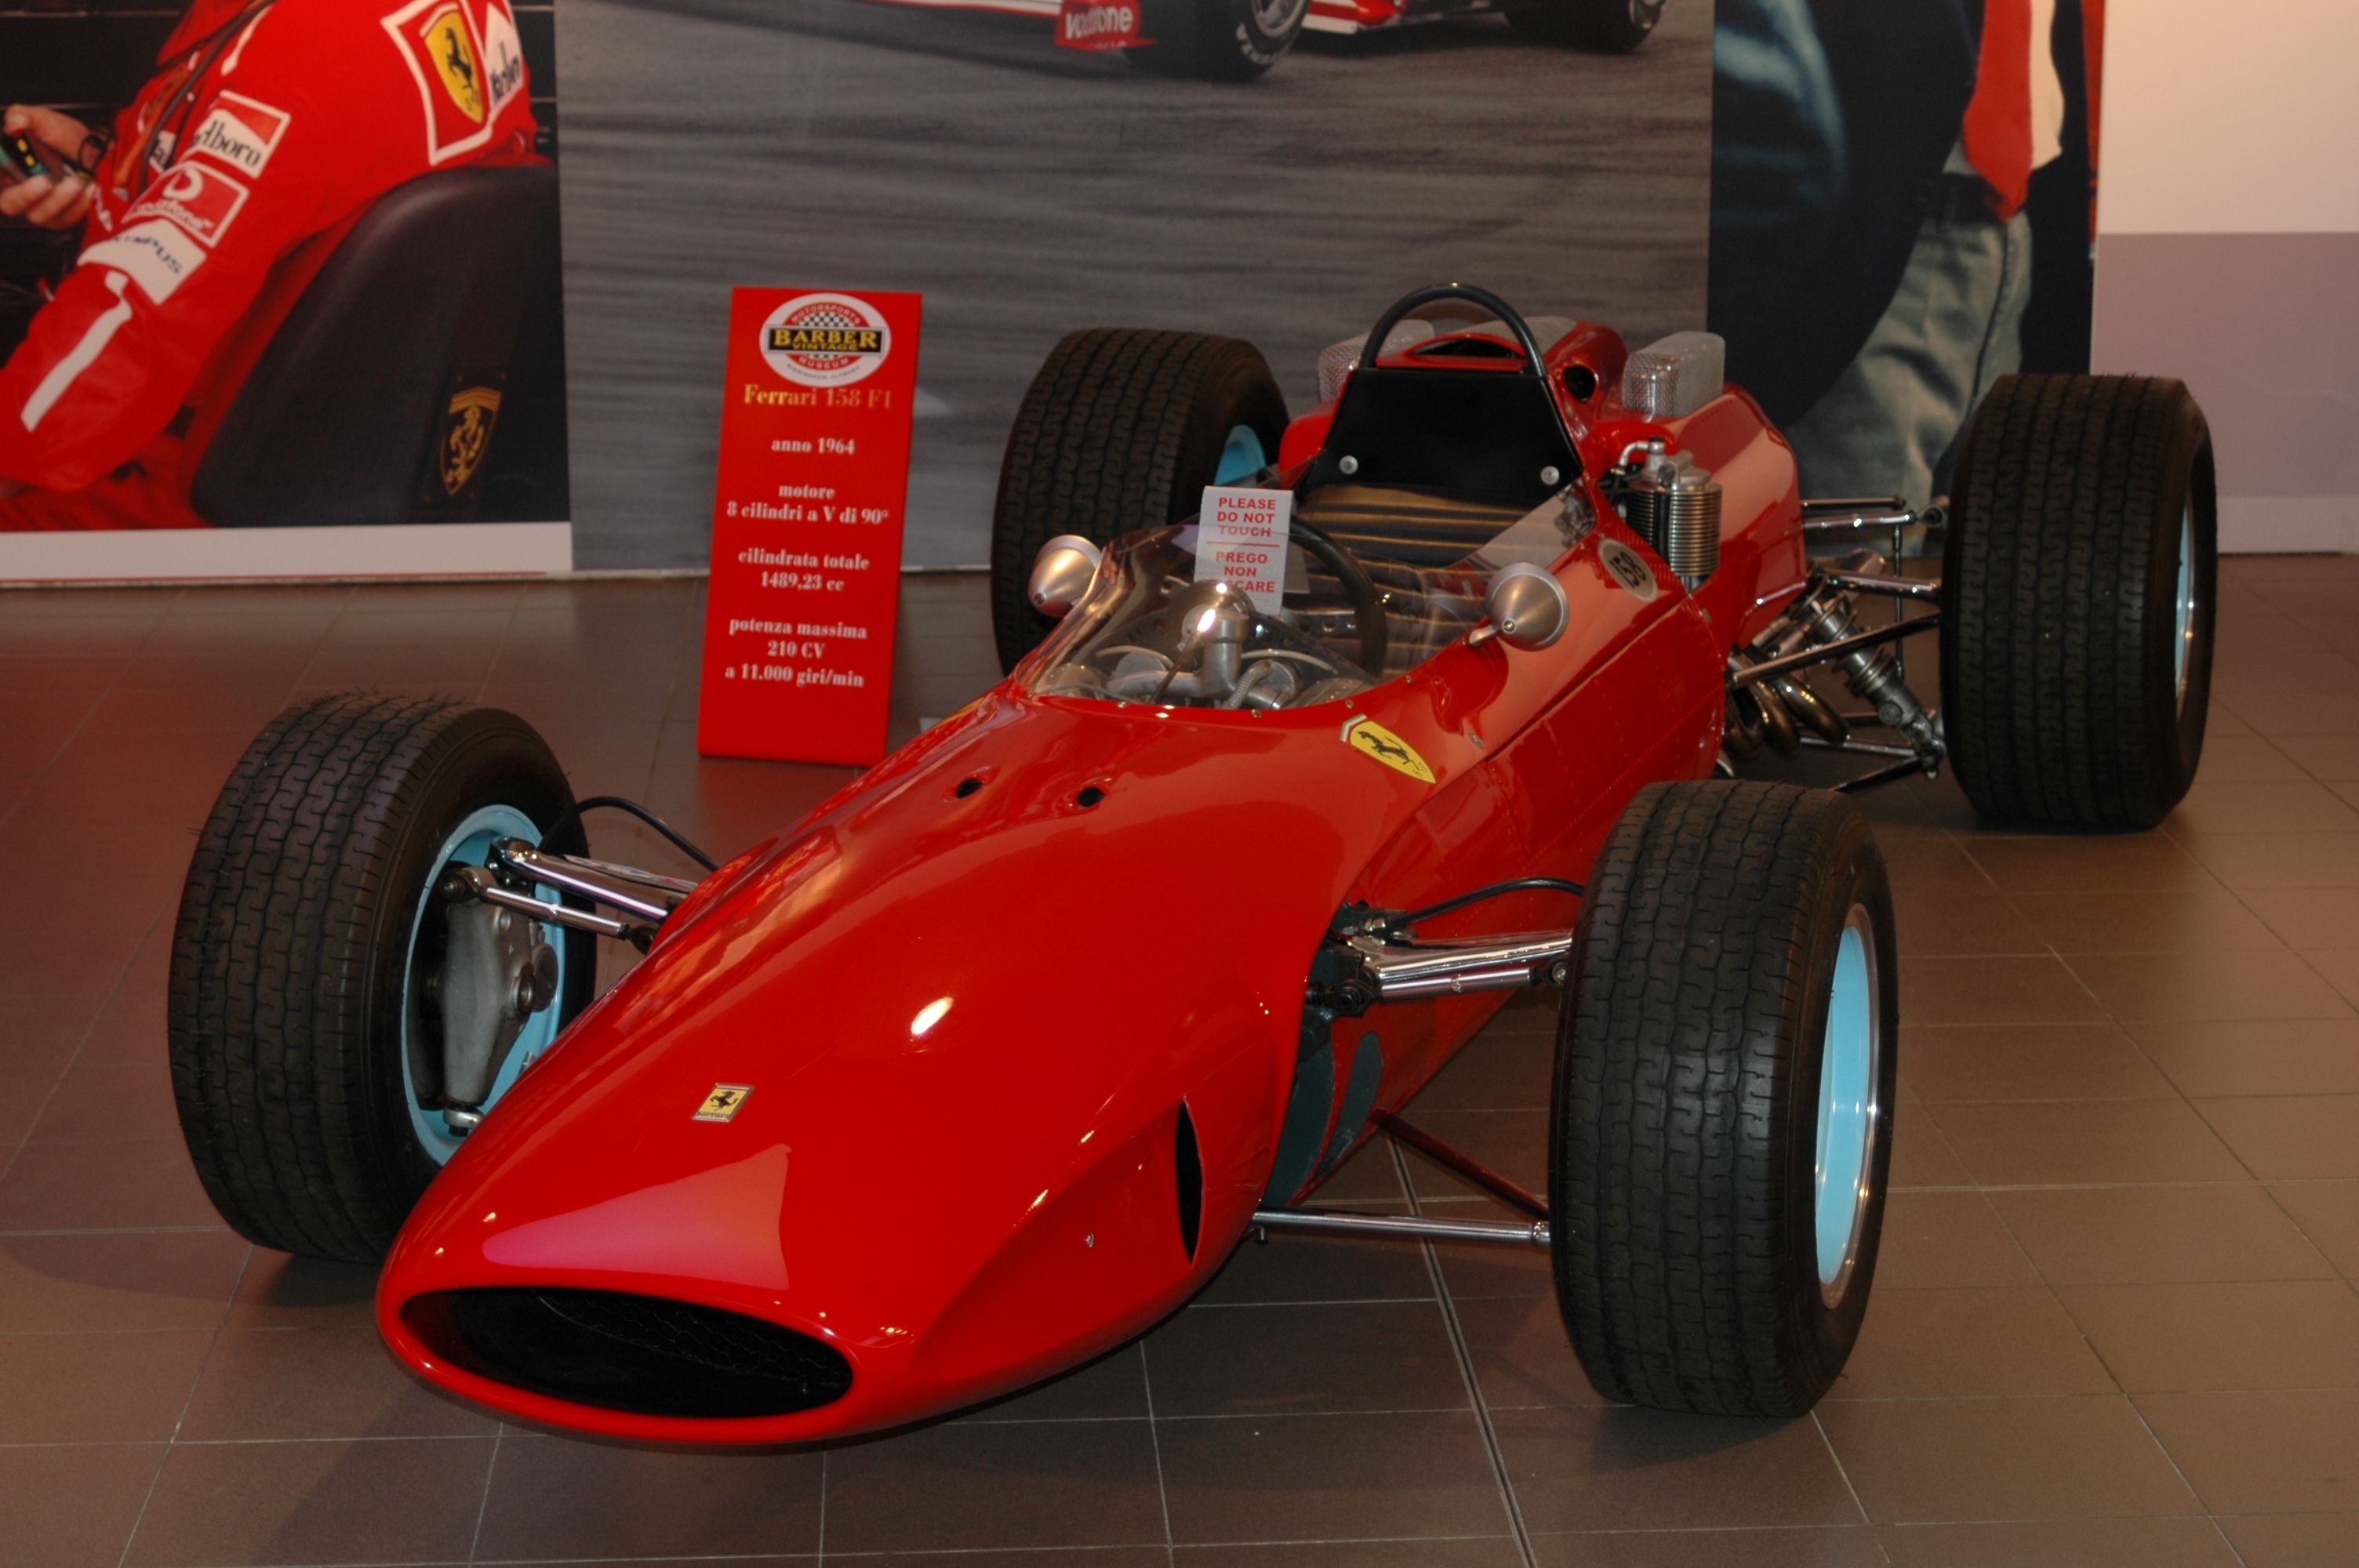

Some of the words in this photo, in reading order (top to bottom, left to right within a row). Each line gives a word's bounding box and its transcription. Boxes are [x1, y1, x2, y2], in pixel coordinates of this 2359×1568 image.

[791, 303, 862, 325] MOTORSPORTS
[773, 328, 878, 350] BARBER
[792, 342, 858, 351] VINTAGE
[798, 356, 849, 369] MUSEUM
[744, 384, 817, 405] Ferrari
[825, 388, 860, 406] 158
[868, 389, 891, 408] F1
[772, 440, 812, 453] anno
[818, 437, 855, 455] 1964
[779, 485, 835, 499] motore
[1218, 497, 1277, 510] PLEASE
[727, 501, 737, 517] 8
[741, 502, 802, 521] cilindri
[807, 510, 818, 521] a
[823, 506, 836, 521] V
[839, 506, 857, 524] di
[861, 508, 889, 525] 90°
[1216, 511, 1238, 522] DO
[1243, 514, 1275, 524] NOT
[1219, 525, 1271, 537] TOUCH
[738, 547, 819, 568] cilindrata
[823, 553, 870, 570] totale
[1216, 551, 1268, 564] PREGO
[1223, 566, 1257, 576] NON
[1608, 551, 1646, 588] 158
[827, 580, 845, 591] cc
[729, 618, 792, 636] potenza
[797, 622, 867, 639] massima
[768, 640, 797, 657] 210
[801, 641, 825, 659] CV
[725, 666, 736, 678] a
[741, 663, 793, 681] 11.000
[797, 668, 864, 688] giri/min
